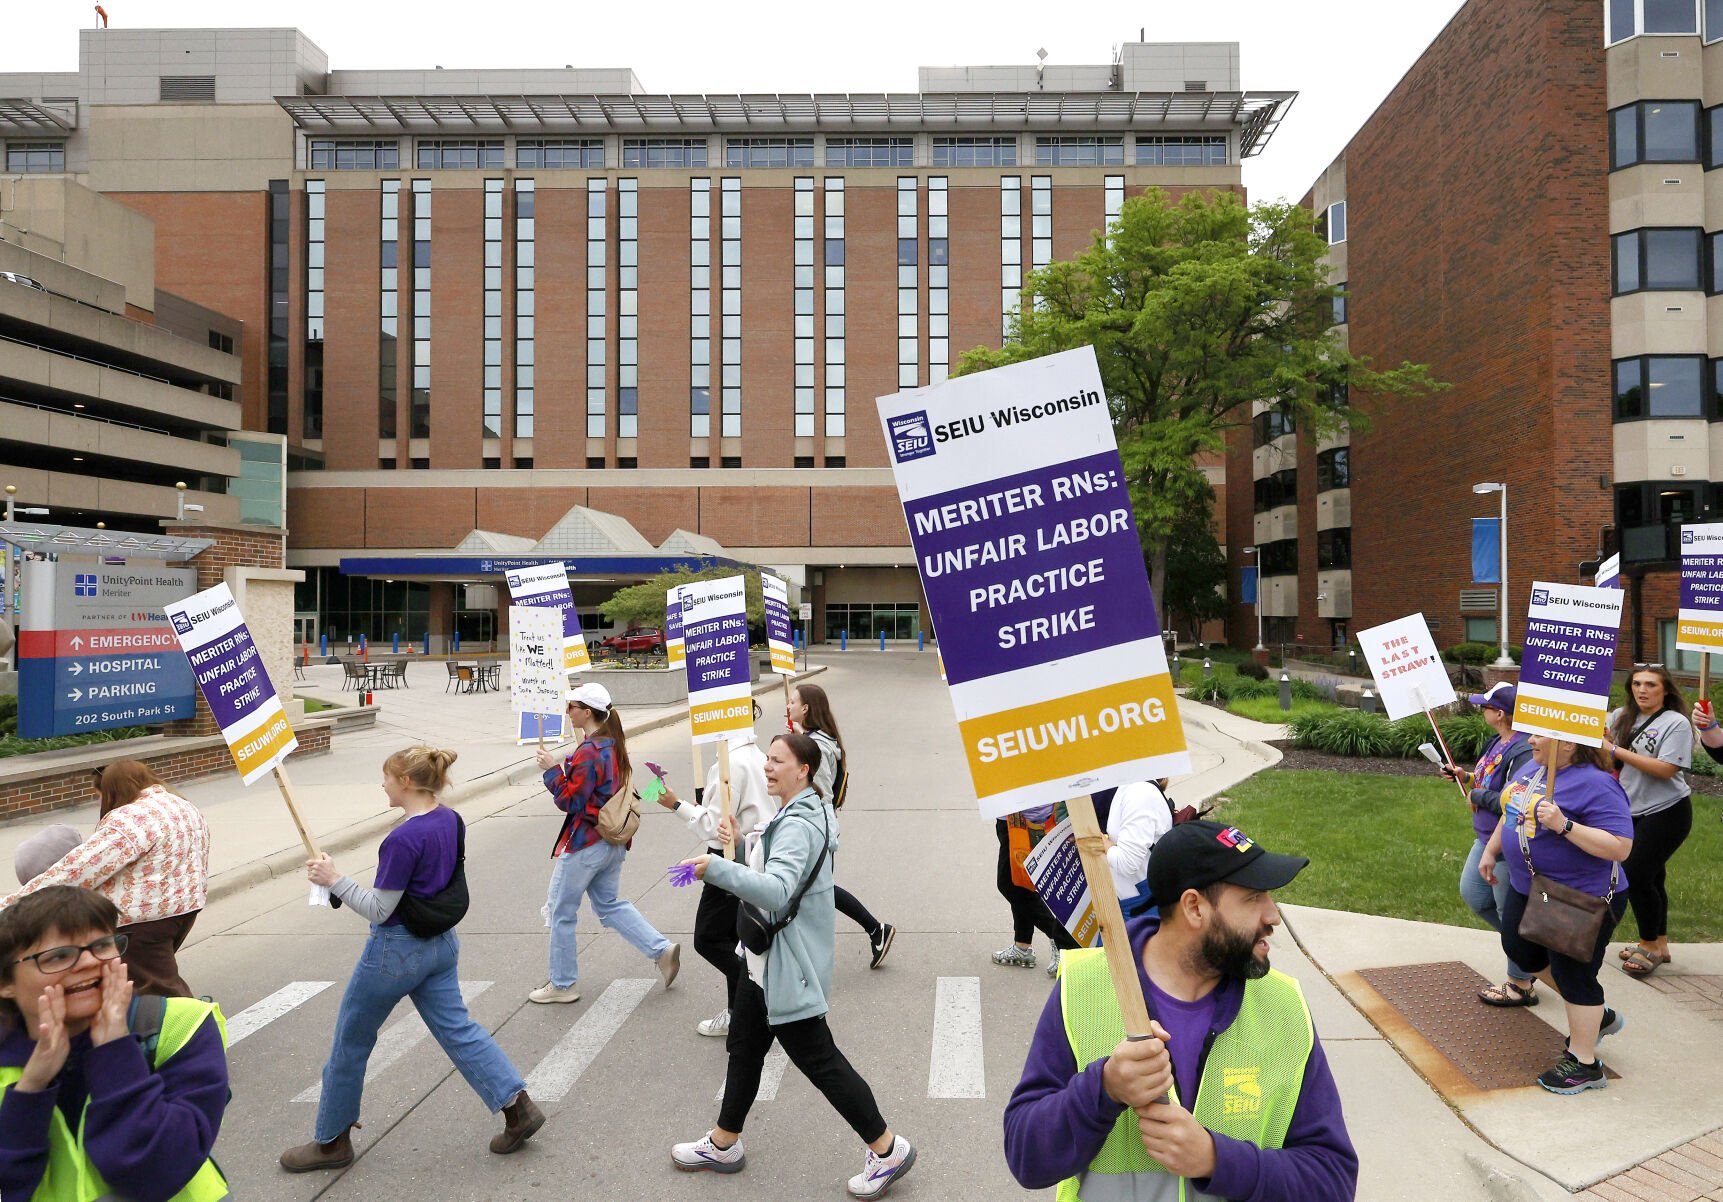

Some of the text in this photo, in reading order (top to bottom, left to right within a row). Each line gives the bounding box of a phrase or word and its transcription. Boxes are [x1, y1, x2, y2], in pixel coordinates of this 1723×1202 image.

[892, 416, 923, 427] Wisconsin
[935, 390, 1100, 442] SEIU Wisconsin
[898, 437, 928, 453] SEIU
[914, 470, 1118, 536] MERITER RNs:
[925, 508, 1130, 578] UNFAIR LABOR
[102, 576, 184, 586] UnityPoint Health
[970, 559, 1105, 612] PRACTICE
[515, 592, 571, 607] MERITER RNs:
[694, 590, 743, 606] SEIU Wisconsin
[1549, 597, 1569, 605] SEIU
[1572, 600, 1620, 610] Wisconsin
[1694, 596, 1720, 604] STRIKE
[190, 600, 235, 624] SEIU Wisconsin
[686, 619, 744, 638] MERITER RNs:
[998, 605, 1095, 649] STRIKE
[1529, 622, 1614, 641] MERITER RNs:
[1681, 626, 1723, 637] SEIUWI.OR
[90, 634, 179, 648] EMERGENCY
[527, 645, 544, 655] WE
[686, 634, 746, 653] UNFAIR LABOR
[1382, 636, 1408, 650] THE
[1526, 637, 1613, 656] UNFAIR LABOR
[191, 639, 235, 666] MERITER
[696, 651, 736, 667] PRACTICE
[1381, 646, 1418, 665] LAST
[1538, 654, 1596, 670] PRACTICE
[89, 658, 161, 674] HOSPITAL
[199, 645, 256, 684] UNFAIR LABOR
[220, 666, 257, 696] PRACTICE
[702, 668, 731, 681] STRIKE
[1543, 670, 1586, 684] STRIKE
[89, 682, 156, 699] PARKING
[234, 686, 261, 709] STRIKE
[75, 705, 175, 725] 202 South Park St
[694, 706, 749, 724] SEIUWI.ORG
[1520, 703, 1599, 726] SEIUWI.ORG
[977, 698, 1166, 763] SEIUWI.ORG
[237, 720, 287, 761] SEIUWI.ORG
[1037, 852, 1062, 891] MERITER
[1056, 858, 1080, 900] PRACTICE
[1044, 869, 1063, 901] UNFAIR
[1066, 872, 1085, 904] STRIKE
